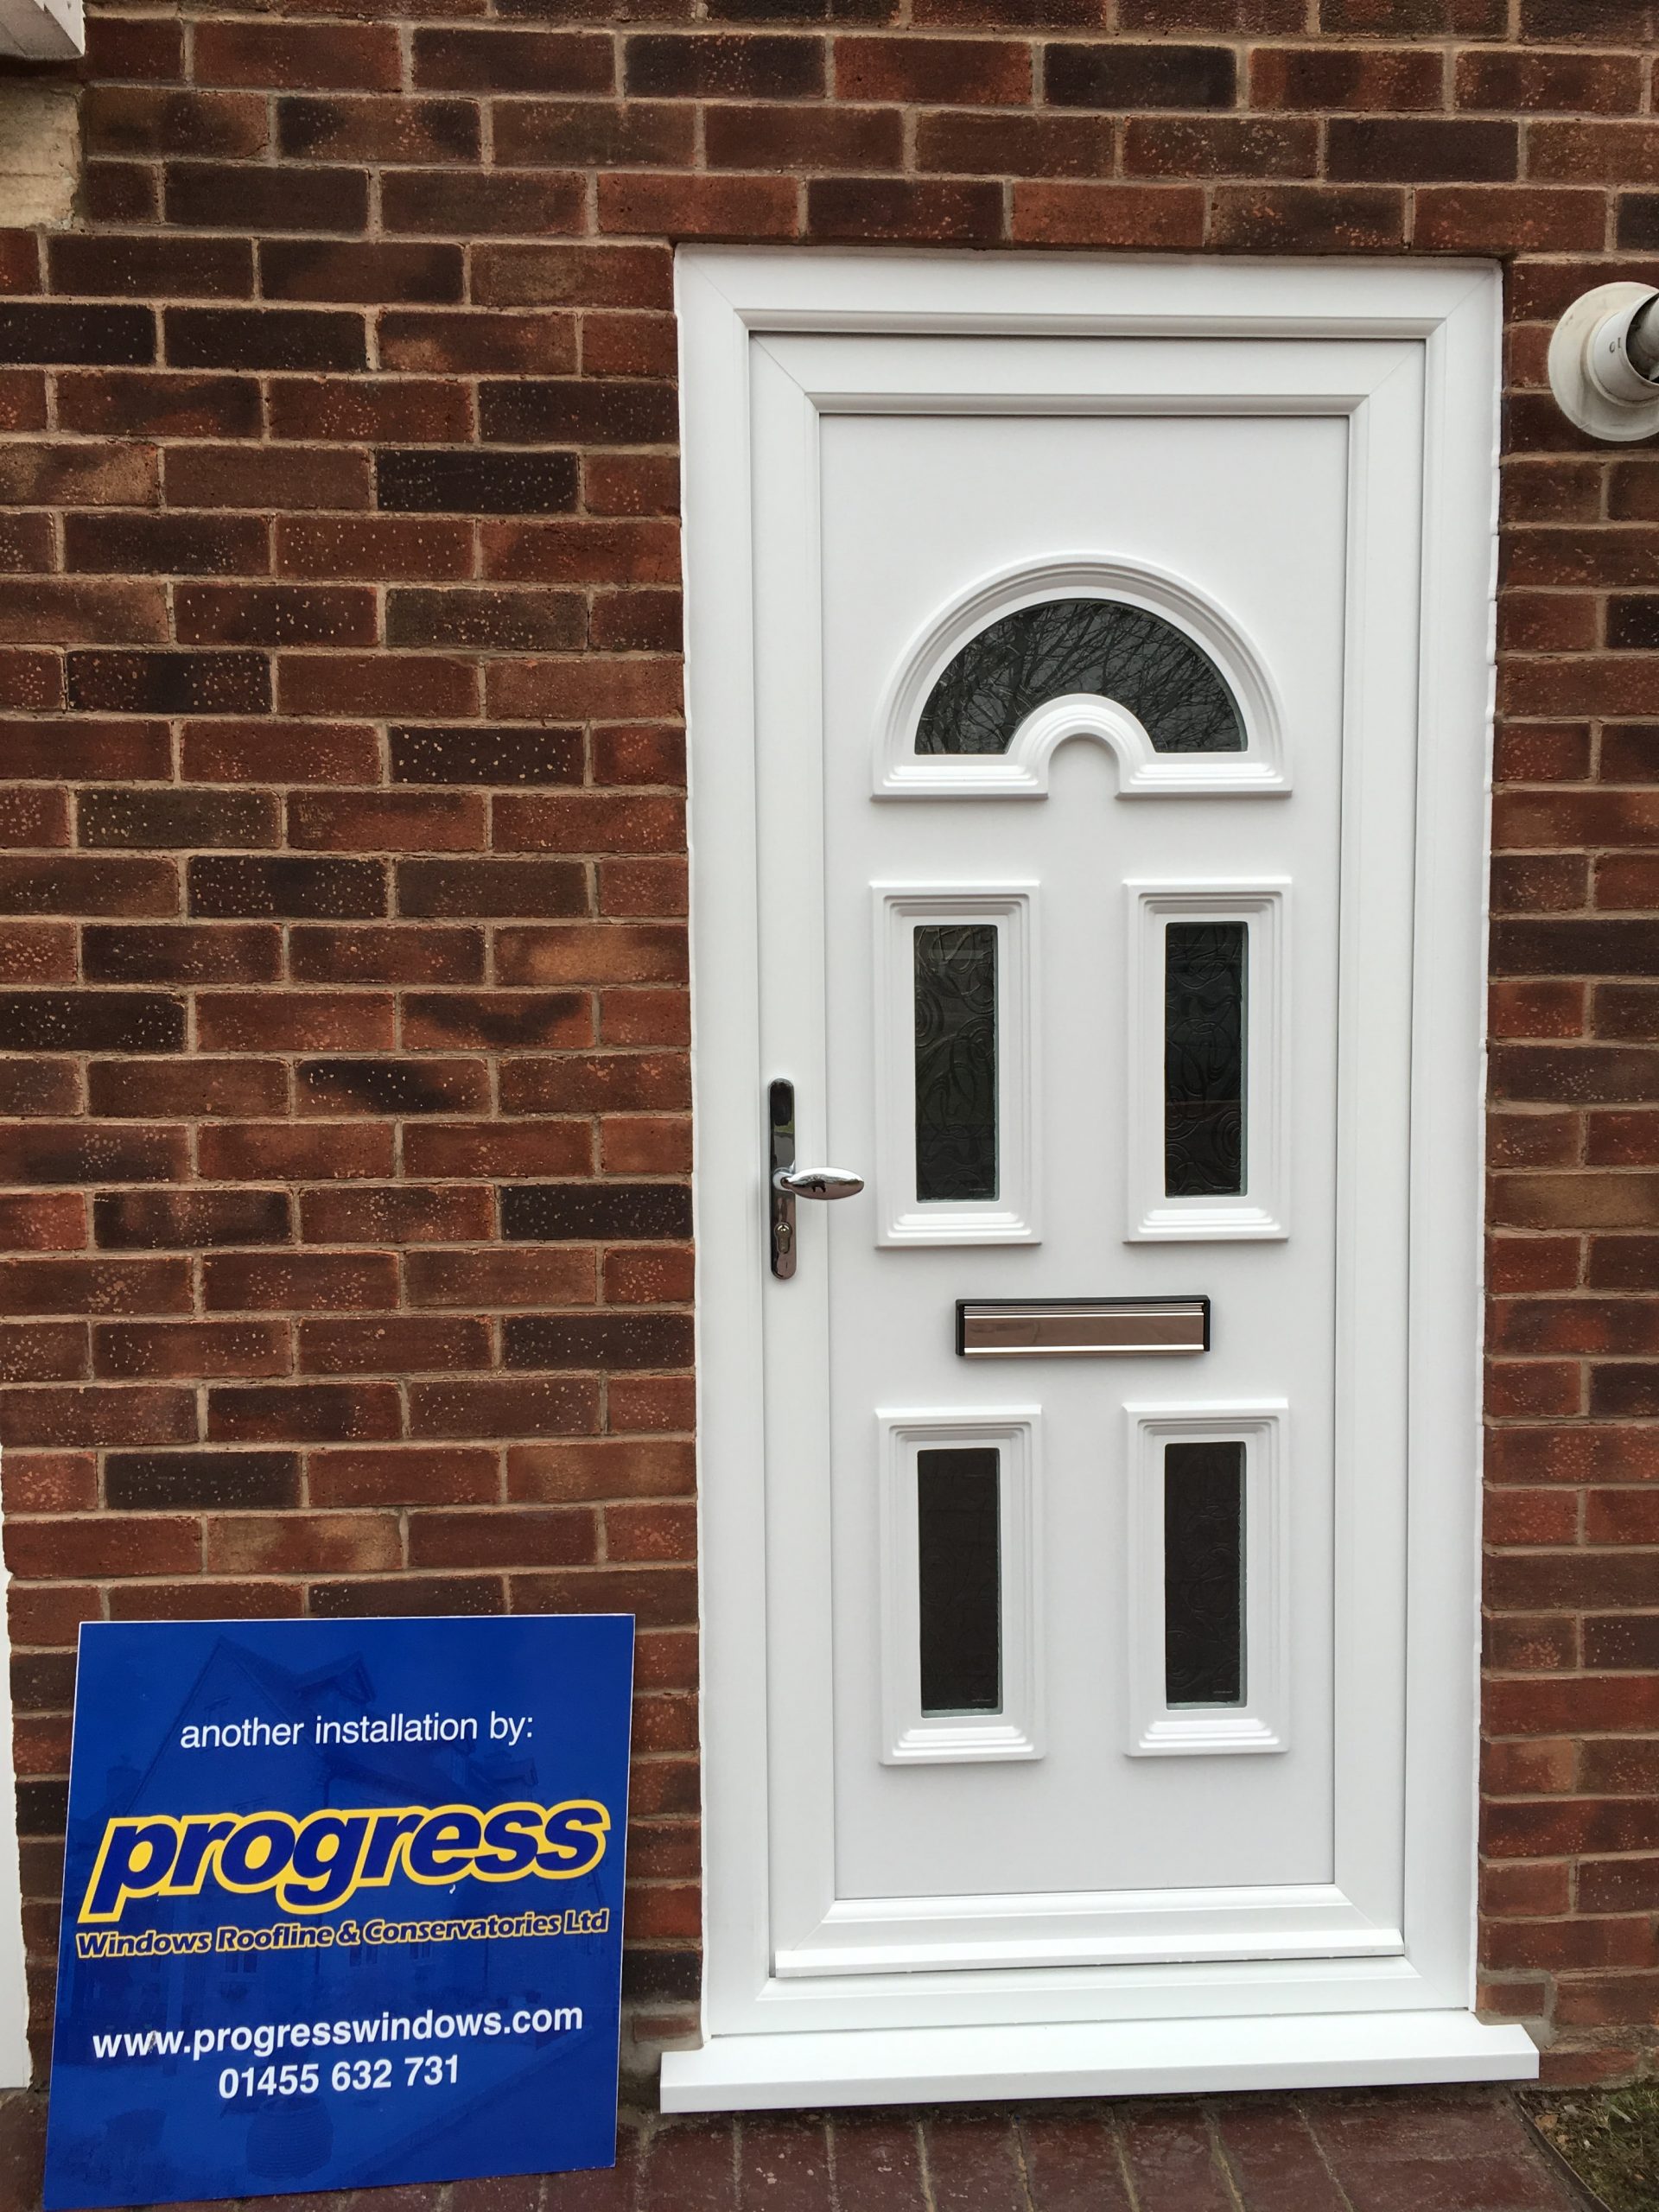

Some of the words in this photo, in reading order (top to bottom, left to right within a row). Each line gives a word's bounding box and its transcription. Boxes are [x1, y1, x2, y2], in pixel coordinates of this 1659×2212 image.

[180, 1718, 305, 1749] another
[315, 1713, 478, 1744] installation
[490, 1710, 533, 1746] by:
[77, 1800, 611, 1923] progress
[76, 1929, 212, 1959] Windows
[215, 1923, 335, 1953] Roofline
[335, 1920, 361, 1946] &
[363, 1910, 562, 1944] Conservatories
[563, 1908, 610, 1935] Ltd
[92, 2007, 583, 2062] www.progresswindows.com
[219, 2063, 320, 2099] 01455
[331, 2058, 392, 2092] 632
[404, 2054, 458, 2087] 731
